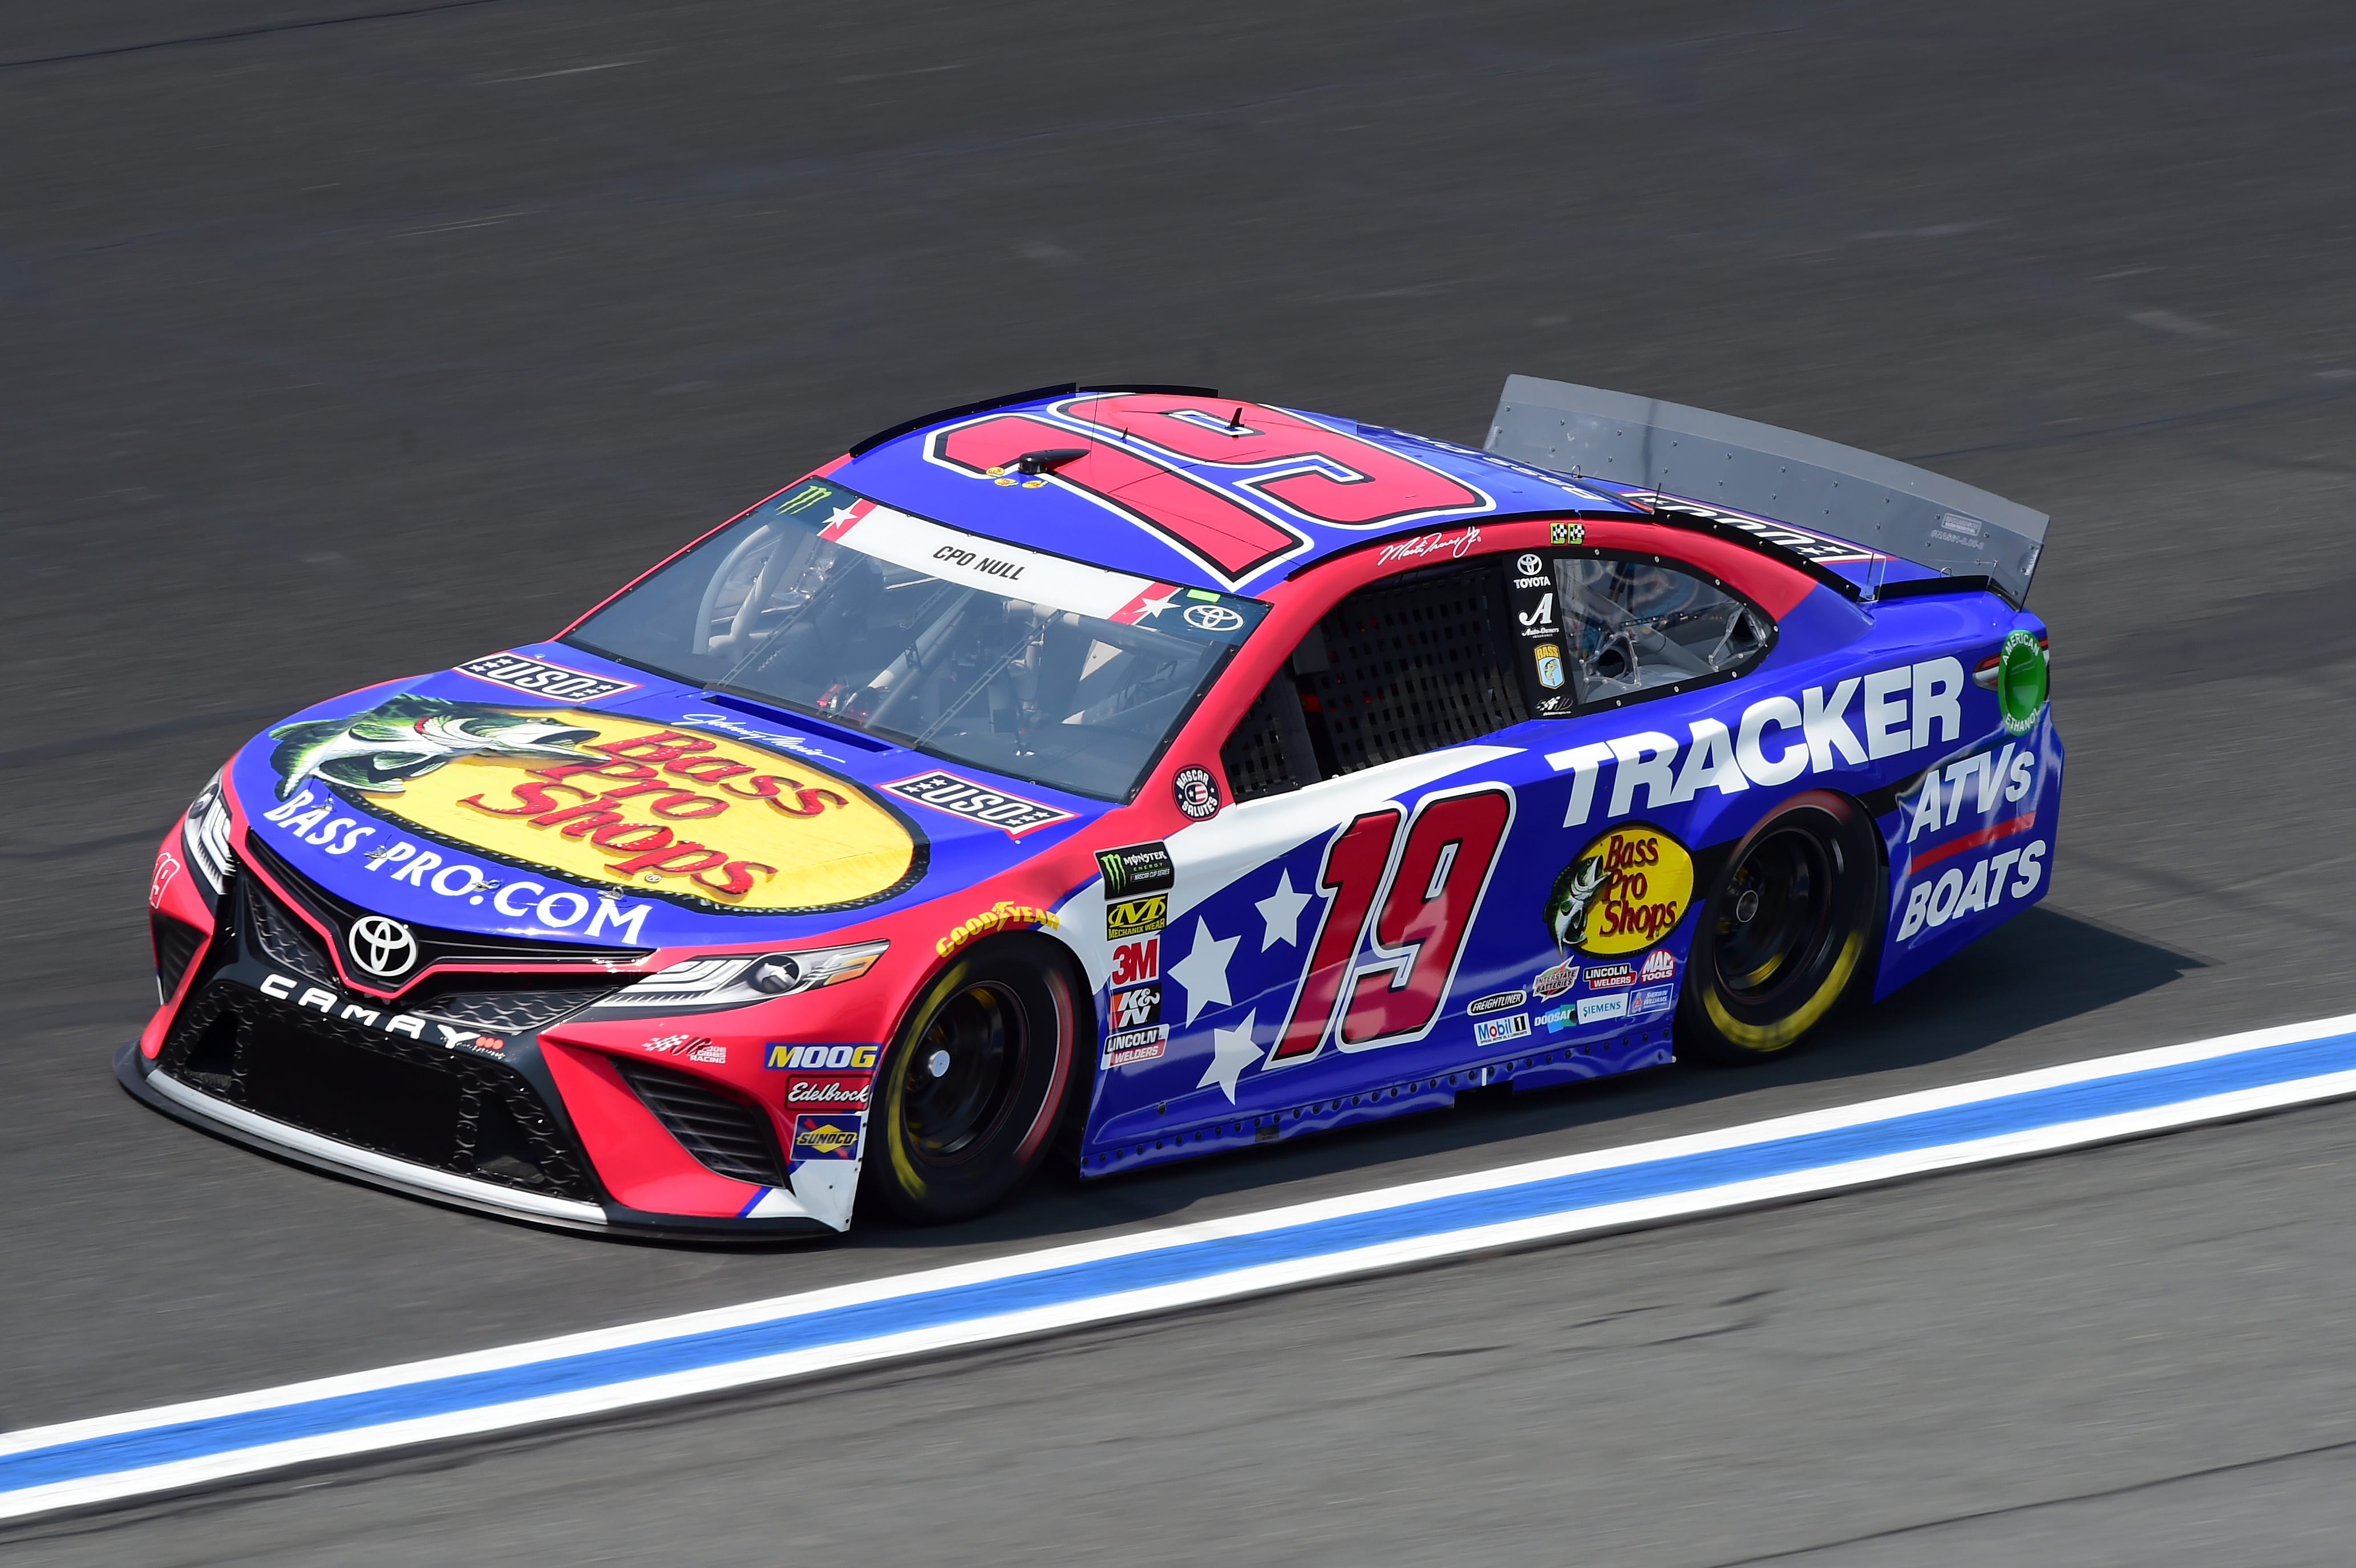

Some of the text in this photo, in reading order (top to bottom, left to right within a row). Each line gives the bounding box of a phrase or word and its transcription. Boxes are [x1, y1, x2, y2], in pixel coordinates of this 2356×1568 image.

[932, 545, 1025, 581] CPO NULL
[1513, 576, 1551, 589] TOYOTA
[1519, 593, 1553, 626] A
[1537, 646, 1558, 660] BASS
[2002, 633, 2039, 665] AMERICAN
[489, 658, 590, 698] USO
[2005, 707, 2041, 732] ETHANOL
[1544, 656, 1965, 828] TRACKER
[581, 730, 848, 819] Bass
[1176, 769, 1209, 790] NASCAR
[524, 757, 730, 820] Pro
[1906, 743, 2035, 844] ATVs
[921, 784, 1027, 828] USO
[1182, 796, 1217, 817] SALUTES
[456, 781, 777, 902] Shops
[1604, 834, 1658, 870] Bass
[262, 788, 653, 945] BASS PRO.COM
[1123, 851, 1167, 866] MONSTER
[1134, 862, 1163, 872] ENERGY
[1602, 869, 1647, 905] Pro
[1896, 840, 2046, 942] BOATS
[936, 901, 1060, 958] GOODYEAR
[1108, 918, 1165, 939] MECHANIX WEAR
[1261, 781, 1517, 1071] 19
[1599, 901, 1677, 939] Shops
[1112, 938, 1157, 985] 3M
[1585, 966, 1628, 979] LINCOLN
[1642, 951, 1673, 974] MAC
[1536, 970, 1576, 985] INTERSTATE
[1536, 979, 1573, 993] BATTERIES
[1594, 976, 1632, 987] WELDERS
[1642, 970, 1672, 982] TOOLS
[1472, 994, 1521, 1012] FREIGHTLINER
[1584, 1001, 1621, 1016] SIEMENS
[1107, 1029, 1158, 1052] LINCOLN
[1477, 1019, 1512, 1040] Mobil
[690, 1055, 726, 1064] RACING
[767, 1046, 879, 1068] MOOG
[1115, 1046, 1159, 1064] WELDERS
[787, 1082, 871, 1103] Edelbrock
[798, 1133, 856, 1145] SUNOCO
